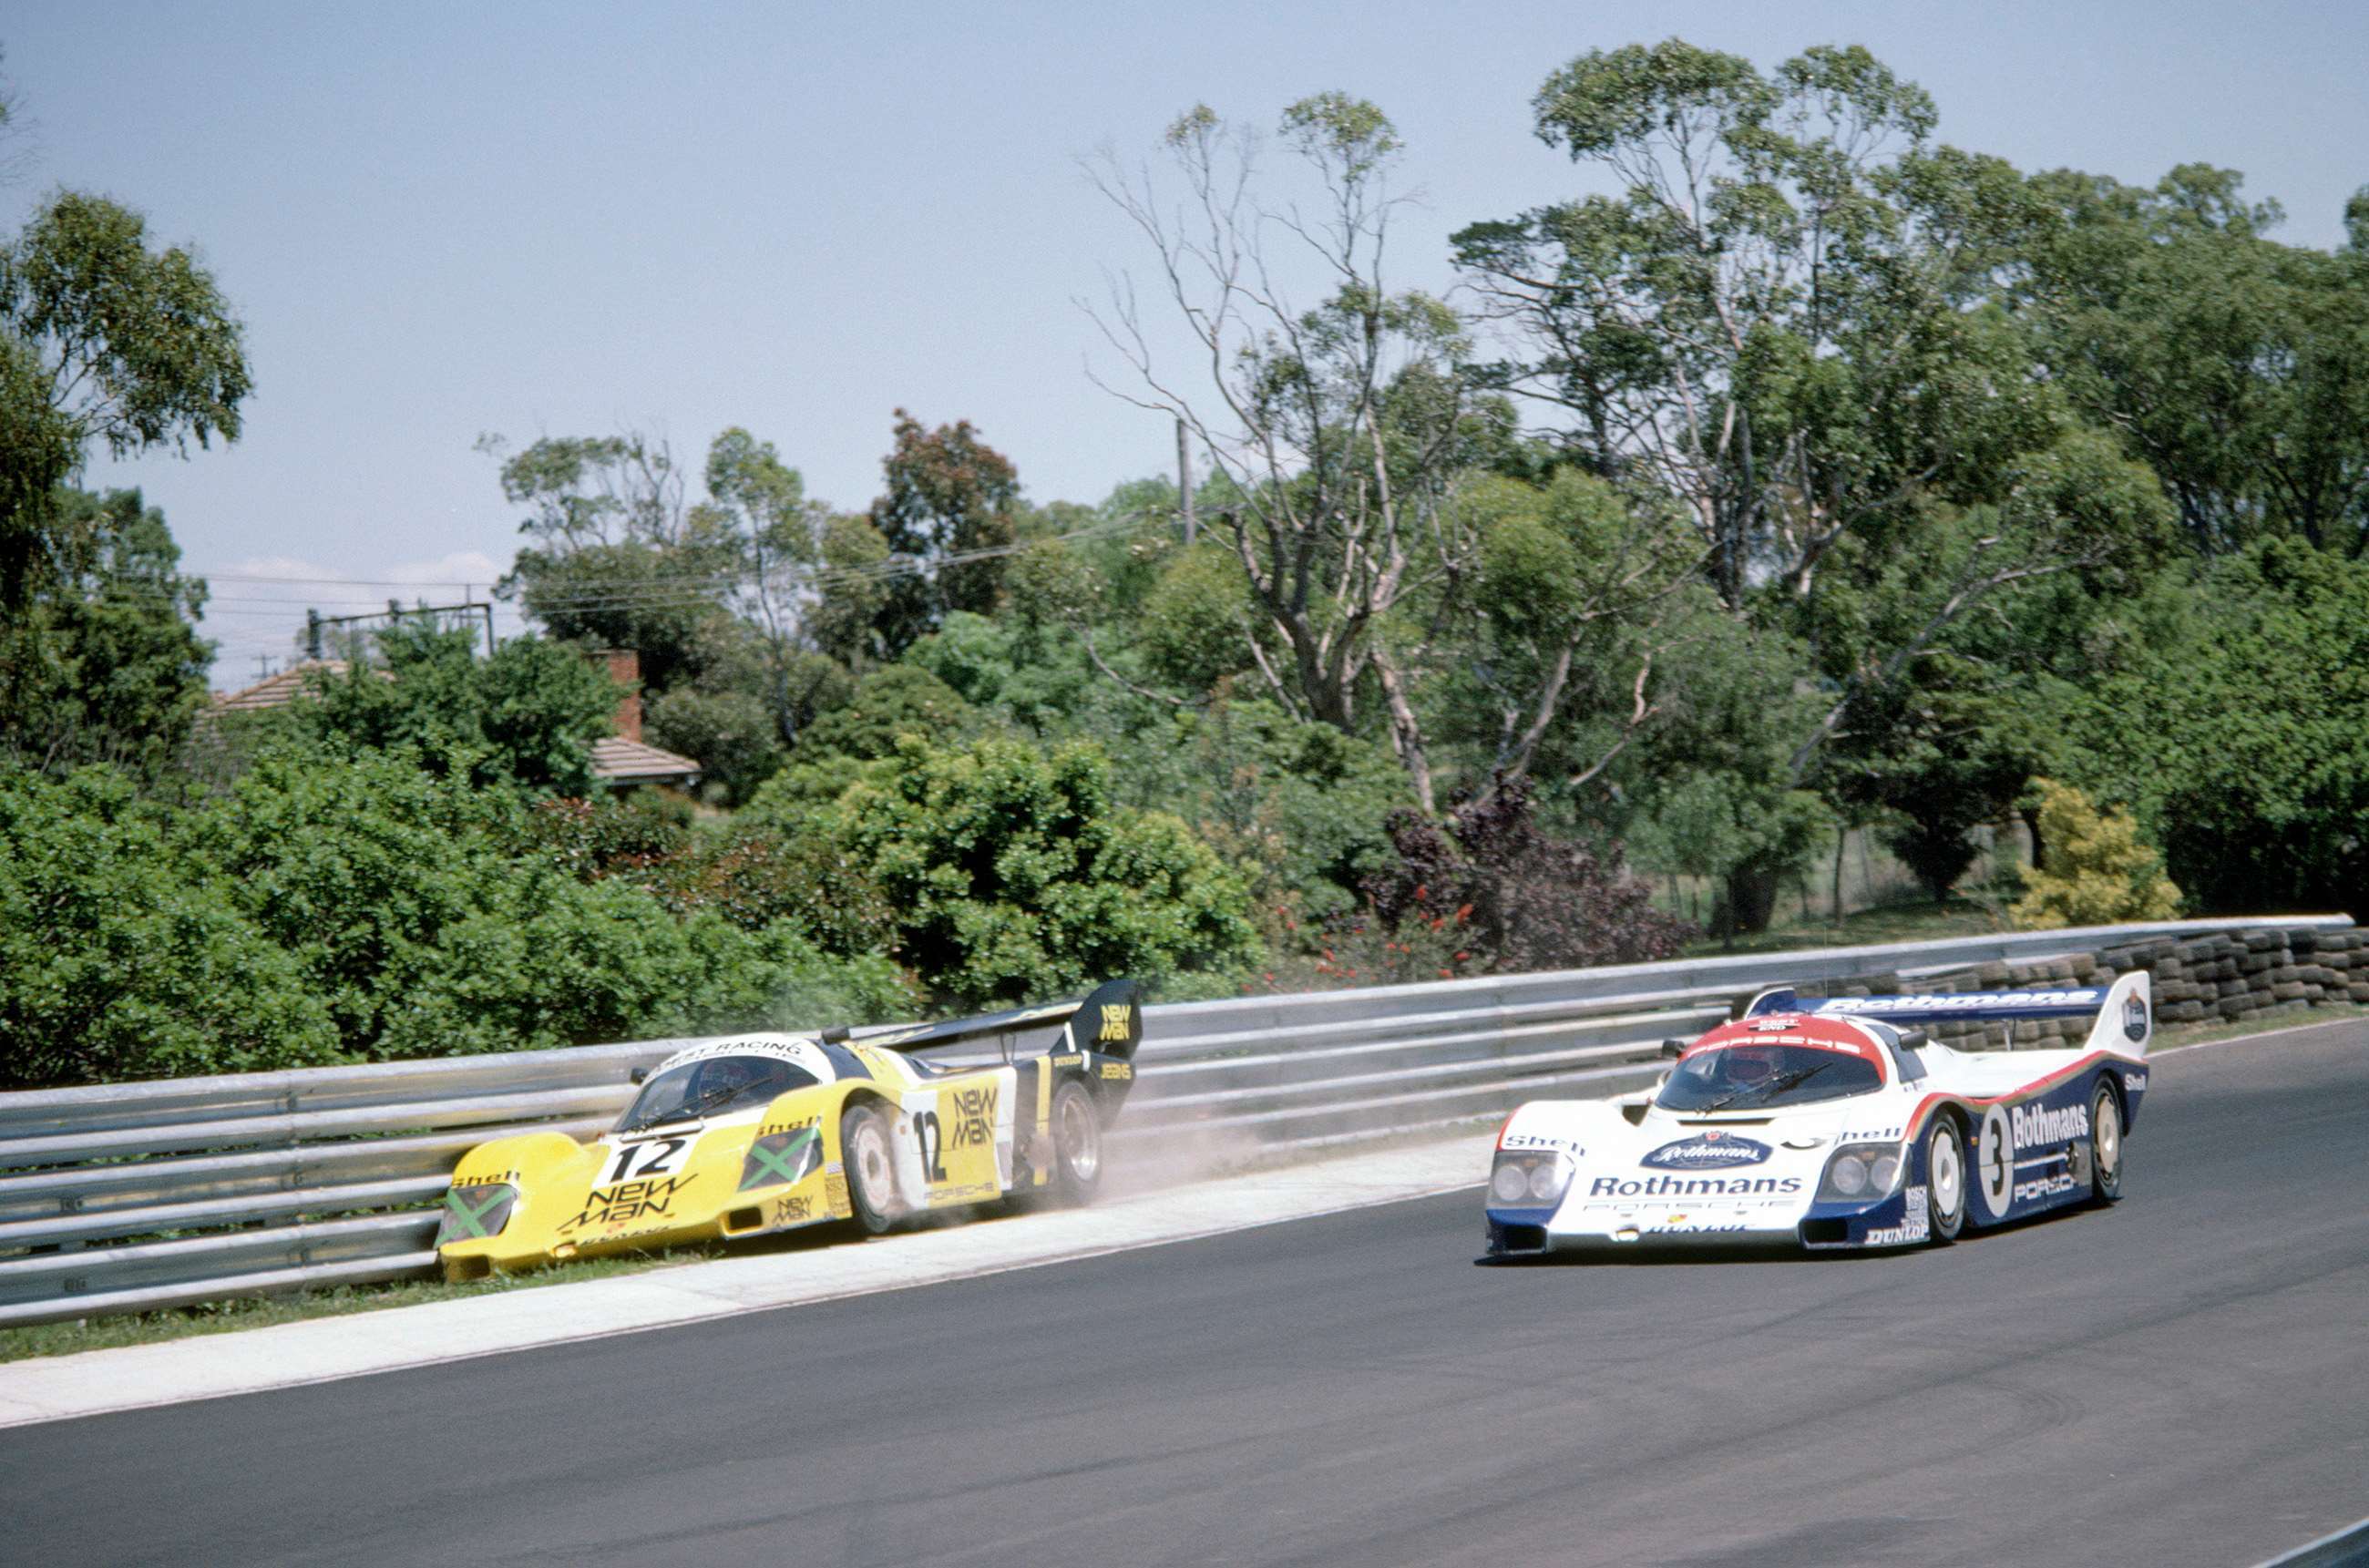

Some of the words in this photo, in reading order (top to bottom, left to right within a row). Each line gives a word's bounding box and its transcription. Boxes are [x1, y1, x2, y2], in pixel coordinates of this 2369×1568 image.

[716, 1041, 802, 1055] RACING
[1687, 1036, 1861, 1058] PORSCHE
[2125, 1073, 2147, 1091] Shell
[1833, 1127, 1902, 1144] hell
[2012, 1103, 2088, 1149] Rothmans
[913, 1111, 947, 1183] 12
[1505, 1135, 1585, 1156] Shell
[1653, 1145, 1760, 1162] Rothmans
[609, 1139, 686, 1184] 12
[1990, 1118, 2005, 1196] 3
[1590, 1175, 1801, 1196] Rothmans
[1864, 1224, 1929, 1245] DUNLOP
